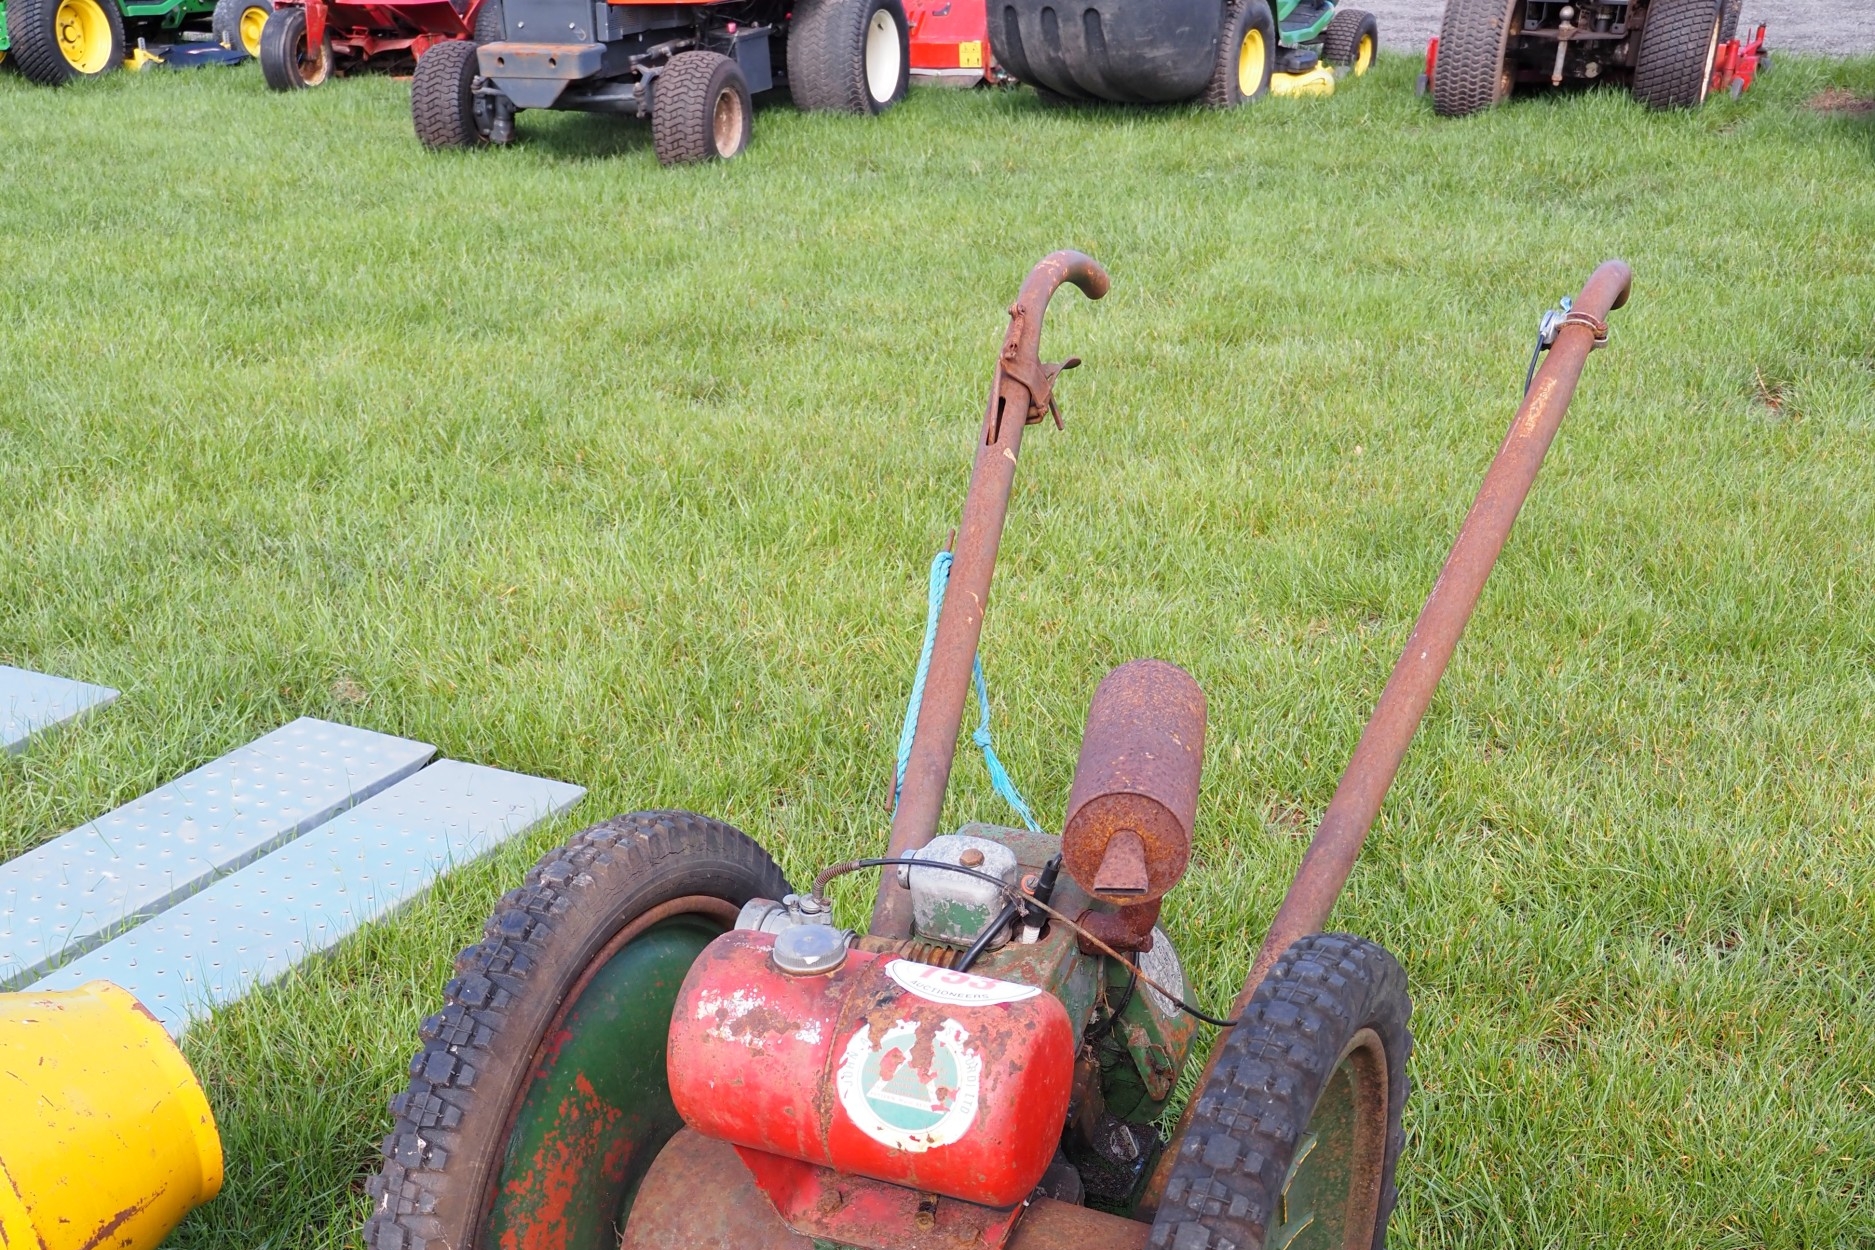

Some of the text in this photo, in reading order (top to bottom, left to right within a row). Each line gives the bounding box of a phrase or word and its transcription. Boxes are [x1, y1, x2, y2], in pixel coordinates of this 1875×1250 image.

[910, 980, 990, 999] AUCTIONEERS
[843, 1050, 859, 1087] JOHN
[960, 1092, 975, 1114] LTD
